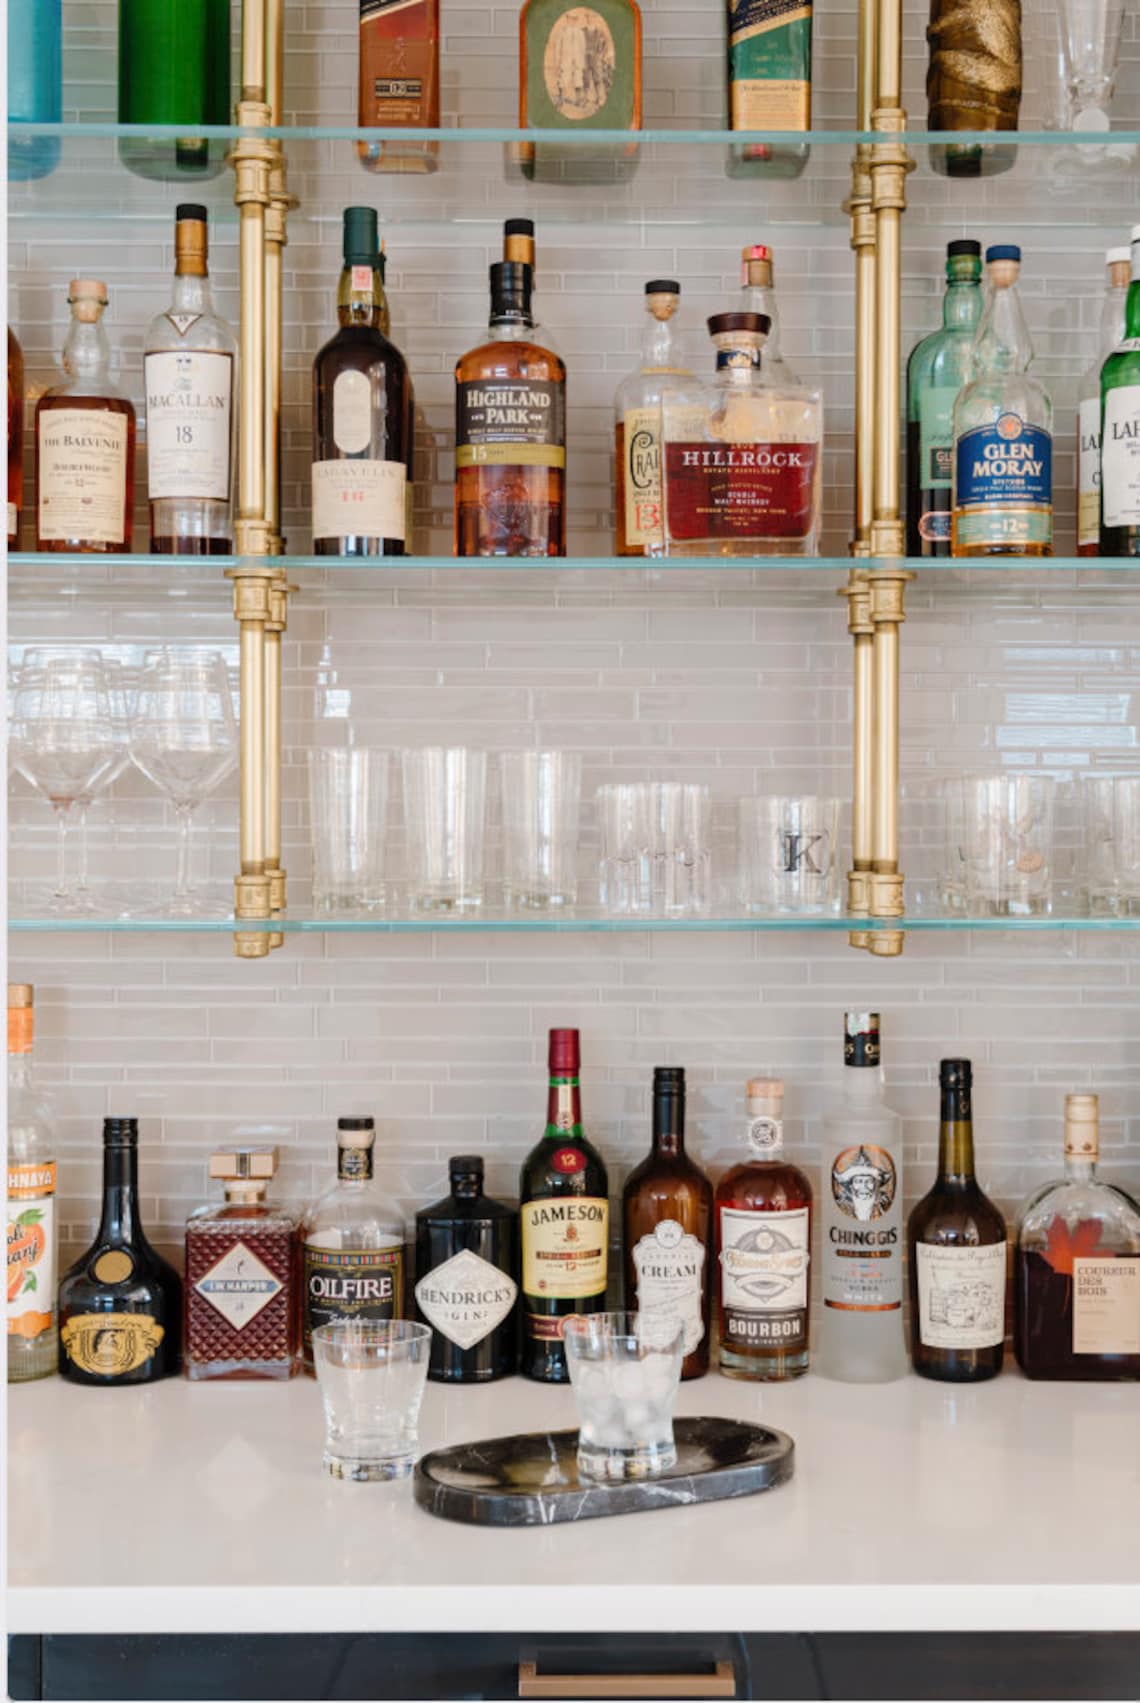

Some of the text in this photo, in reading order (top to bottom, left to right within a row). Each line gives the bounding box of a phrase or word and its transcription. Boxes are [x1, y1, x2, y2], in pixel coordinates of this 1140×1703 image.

[148, 393, 225, 408] MACALLAN
[466, 389, 551, 408] HIGHLAND
[485, 408, 529, 424] PARK
[63, 435, 120, 449] BALVENIE
[176, 425, 193, 444] 18
[472, 445, 488, 461] 15
[682, 451, 803, 467] HILLROCK
[984, 443, 1035, 460] GLEN
[972, 459, 1043, 478] MORAY
[341, 490, 365, 503] 16
[634, 503, 661, 530] 13
[1003, 518, 1019, 533] 12
[783, 833, 823, 873] K
[560, 1153, 577, 1167] 12
[531, 1204, 605, 1226] JAMESON
[829, 1226, 898, 1245] CHINGGIS
[641, 1264, 697, 1278] CREAM
[309, 1275, 393, 1299] OILFIRE
[1078, 1277, 1104, 1286] DES
[420, 1287, 512, 1304] HENDRICK'S
[1078, 1287, 1108, 1297] BOIS
[451, 1311, 481, 1321] GIN
[728, 1318, 801, 1338] BOURBON
